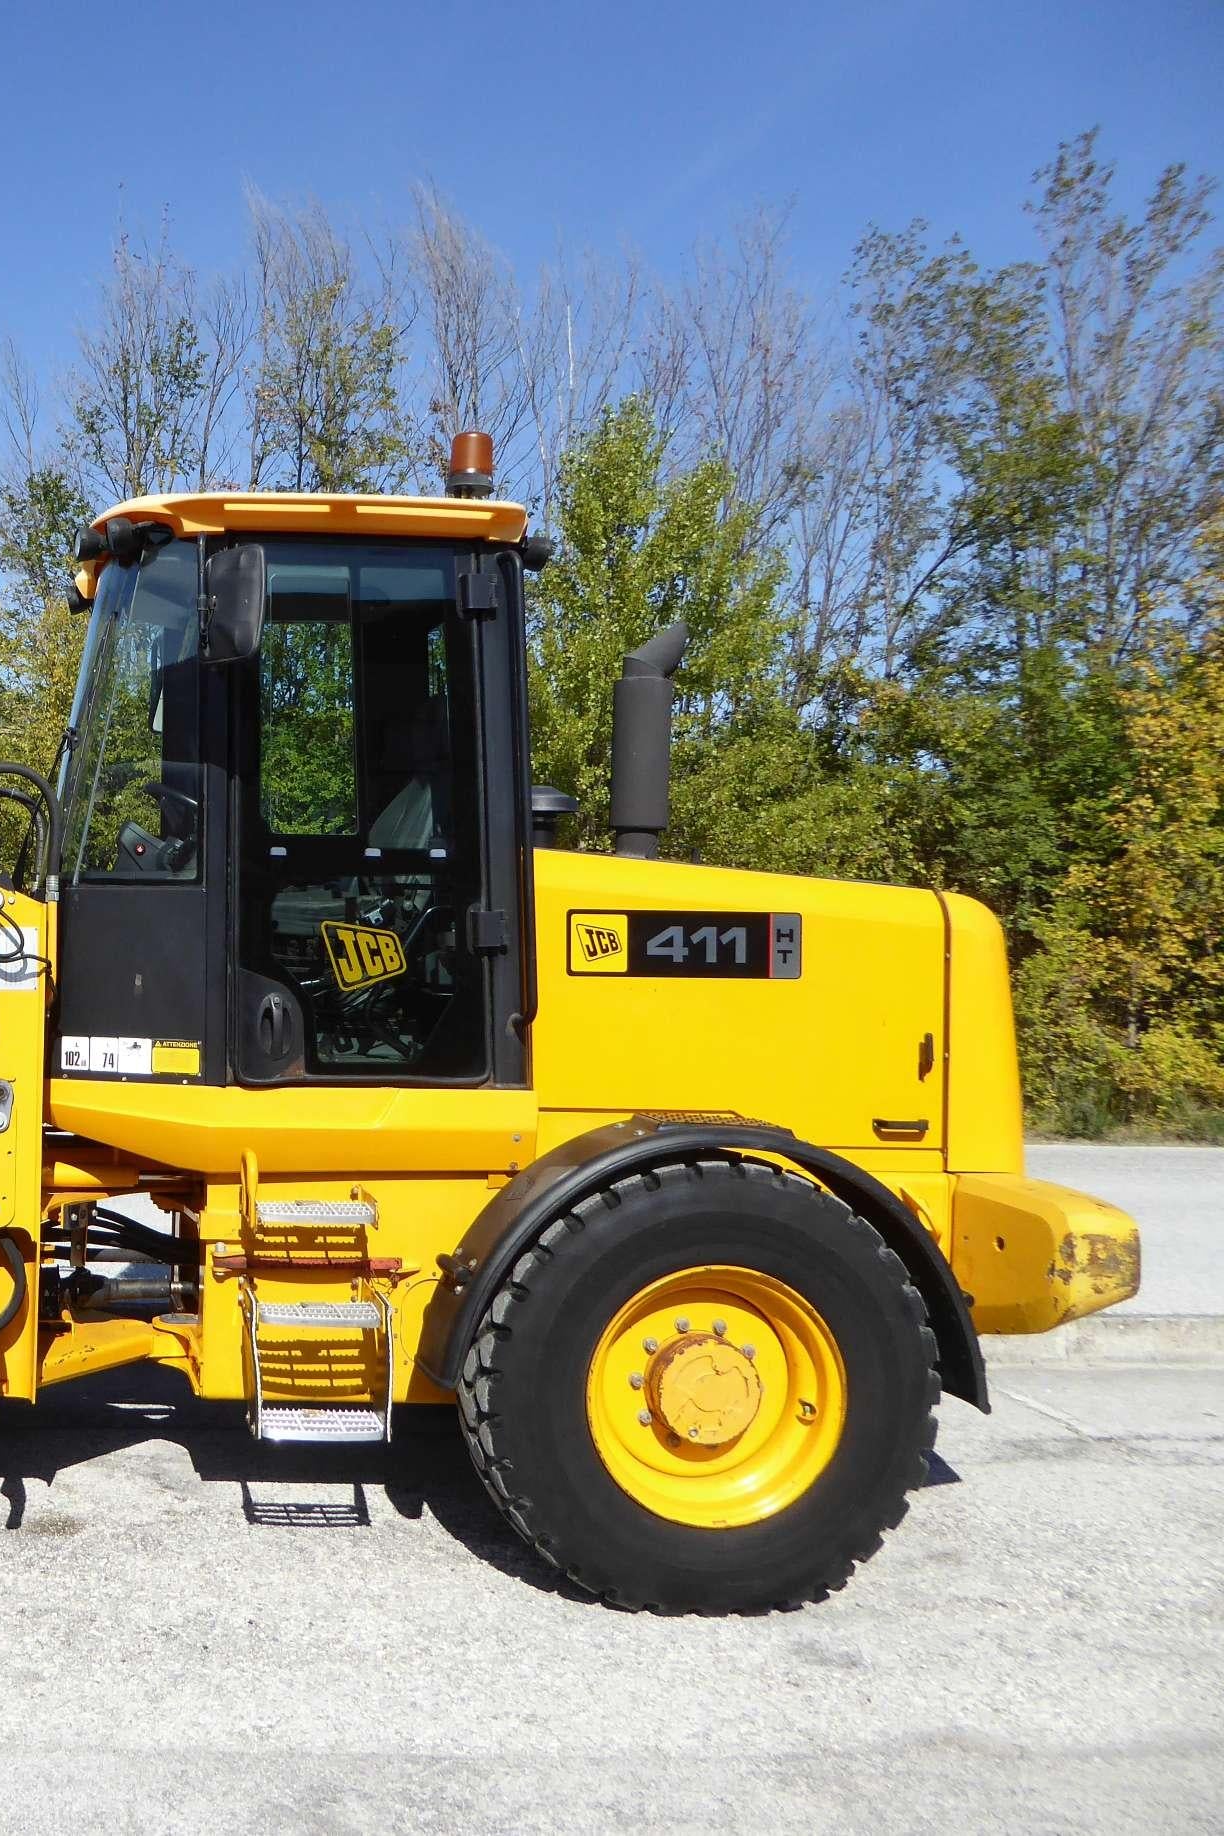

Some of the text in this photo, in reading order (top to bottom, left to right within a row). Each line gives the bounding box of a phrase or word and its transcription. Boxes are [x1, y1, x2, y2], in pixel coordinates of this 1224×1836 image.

[336, 929, 400, 983] JCB
[585, 926, 746, 963] JCB 411
[65, 1051, 80, 1066] 102
[103, 1052, 114, 1068] 74
